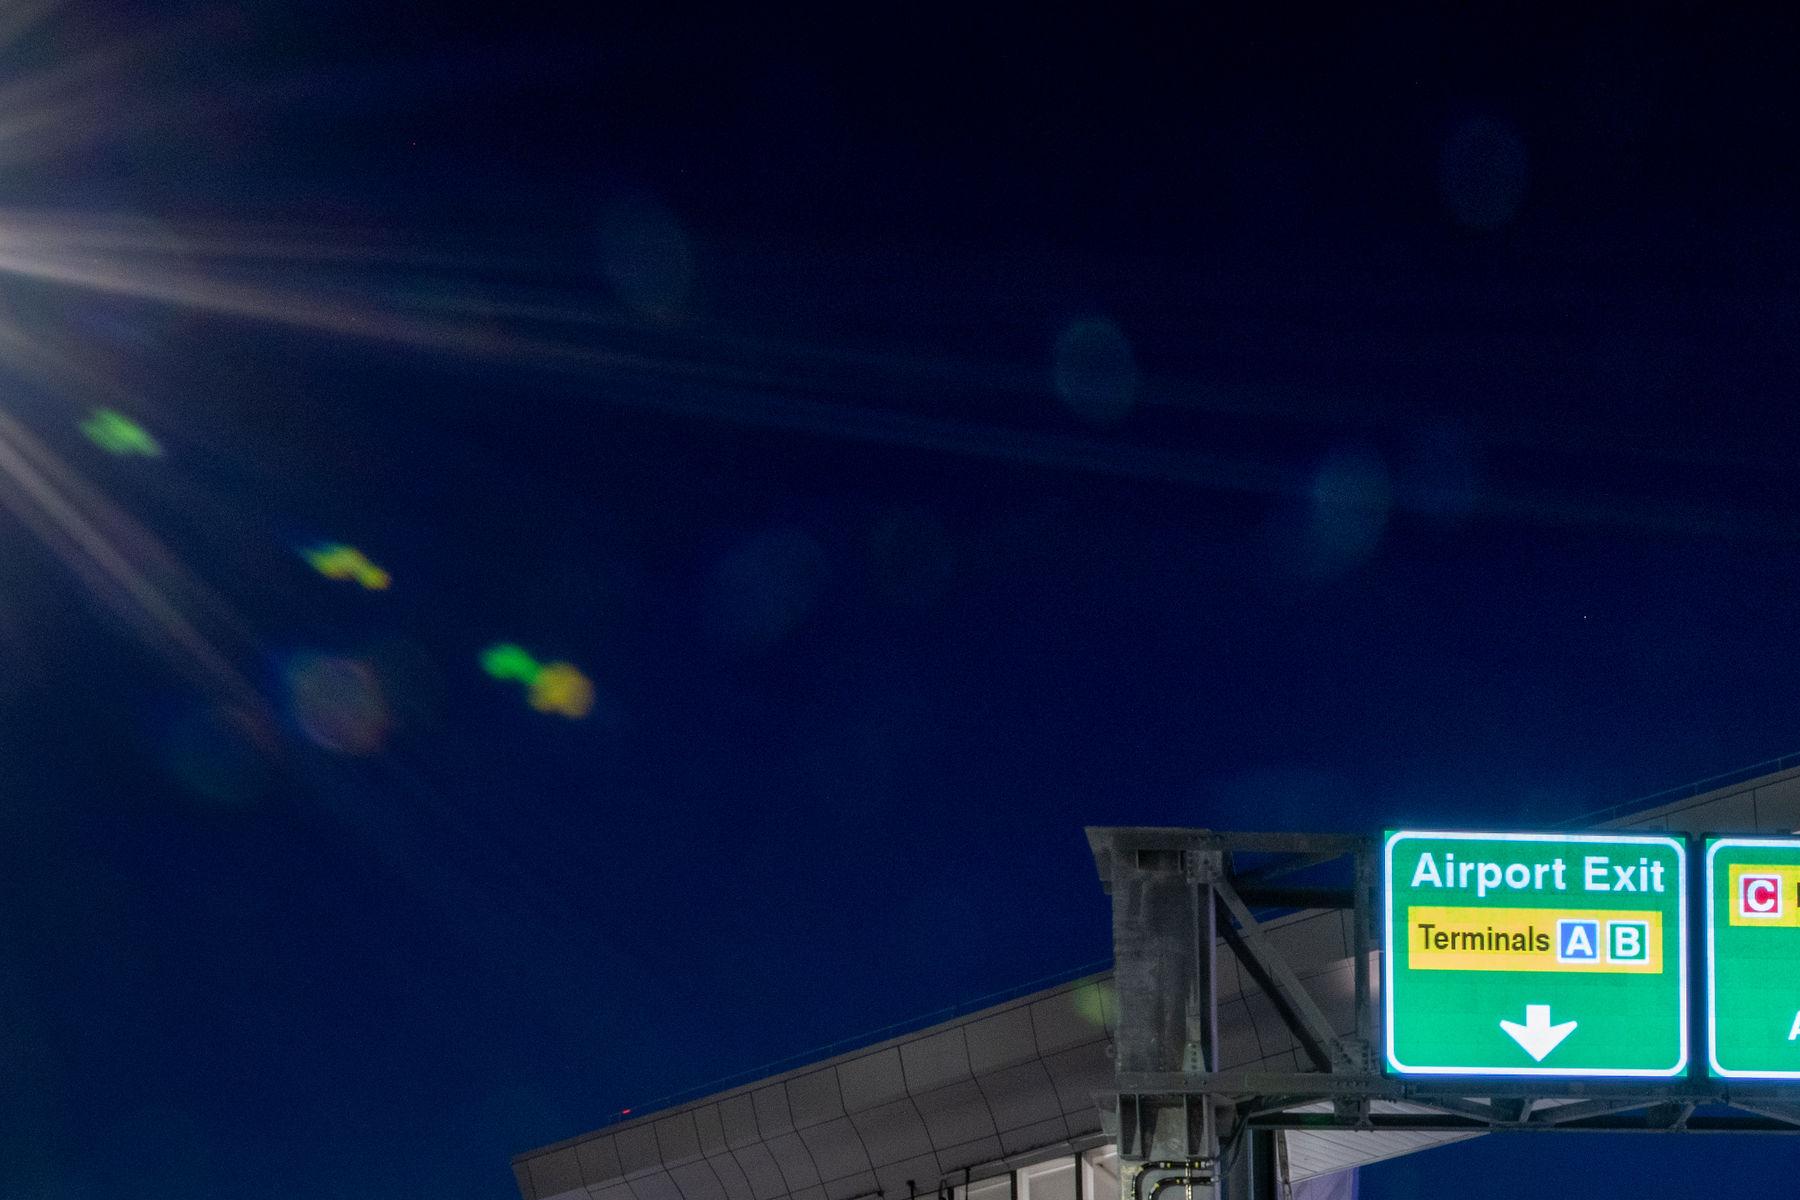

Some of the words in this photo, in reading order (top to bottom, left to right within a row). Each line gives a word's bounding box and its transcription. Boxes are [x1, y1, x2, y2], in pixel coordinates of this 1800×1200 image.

[1411, 852, 1567, 898] Airport
[1583, 856, 1666, 893] Exit
[1746, 878, 1777, 914] C
[1417, 923, 1551, 953] Terminals
[1564, 925, 1594, 957] A
[1613, 927, 1642, 957] B
